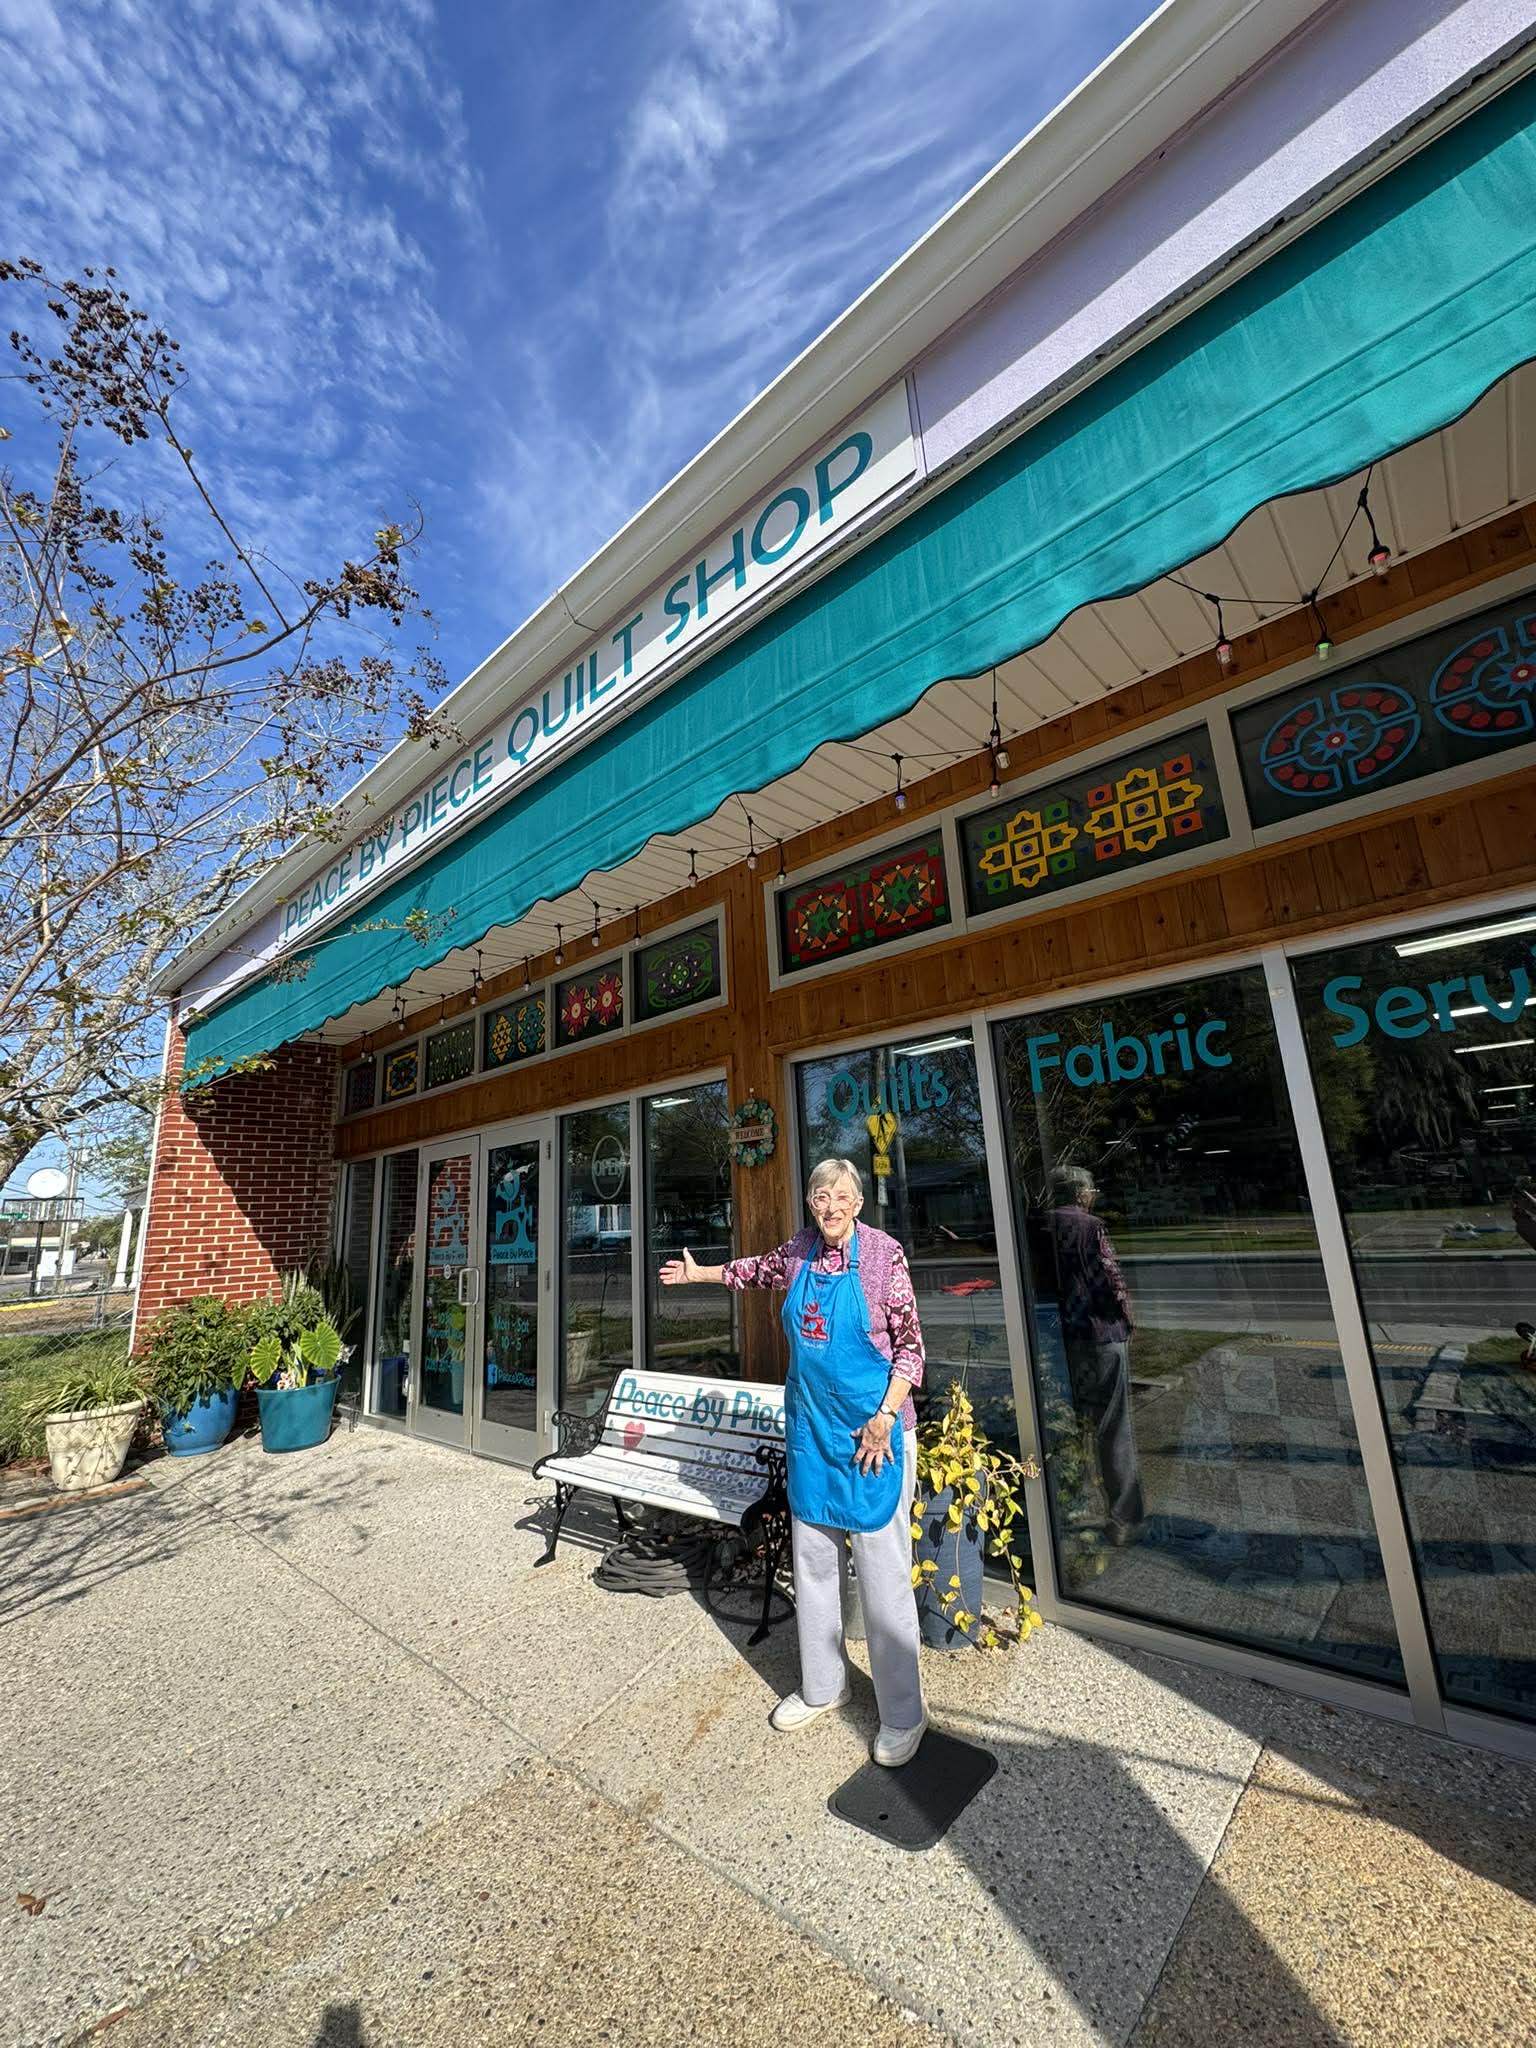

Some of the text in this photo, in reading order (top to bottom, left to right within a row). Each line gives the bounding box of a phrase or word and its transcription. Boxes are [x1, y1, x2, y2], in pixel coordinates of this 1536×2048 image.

[284, 431, 874, 938] PEACE BY PIECE QUILT SHOP
[1323, 944, 1536, 1048] Serv
[1026, 1012, 1233, 1094] Fabric
[827, 1061, 949, 1129] Quilts
[615, 1377, 786, 1437] Peace by Piec
